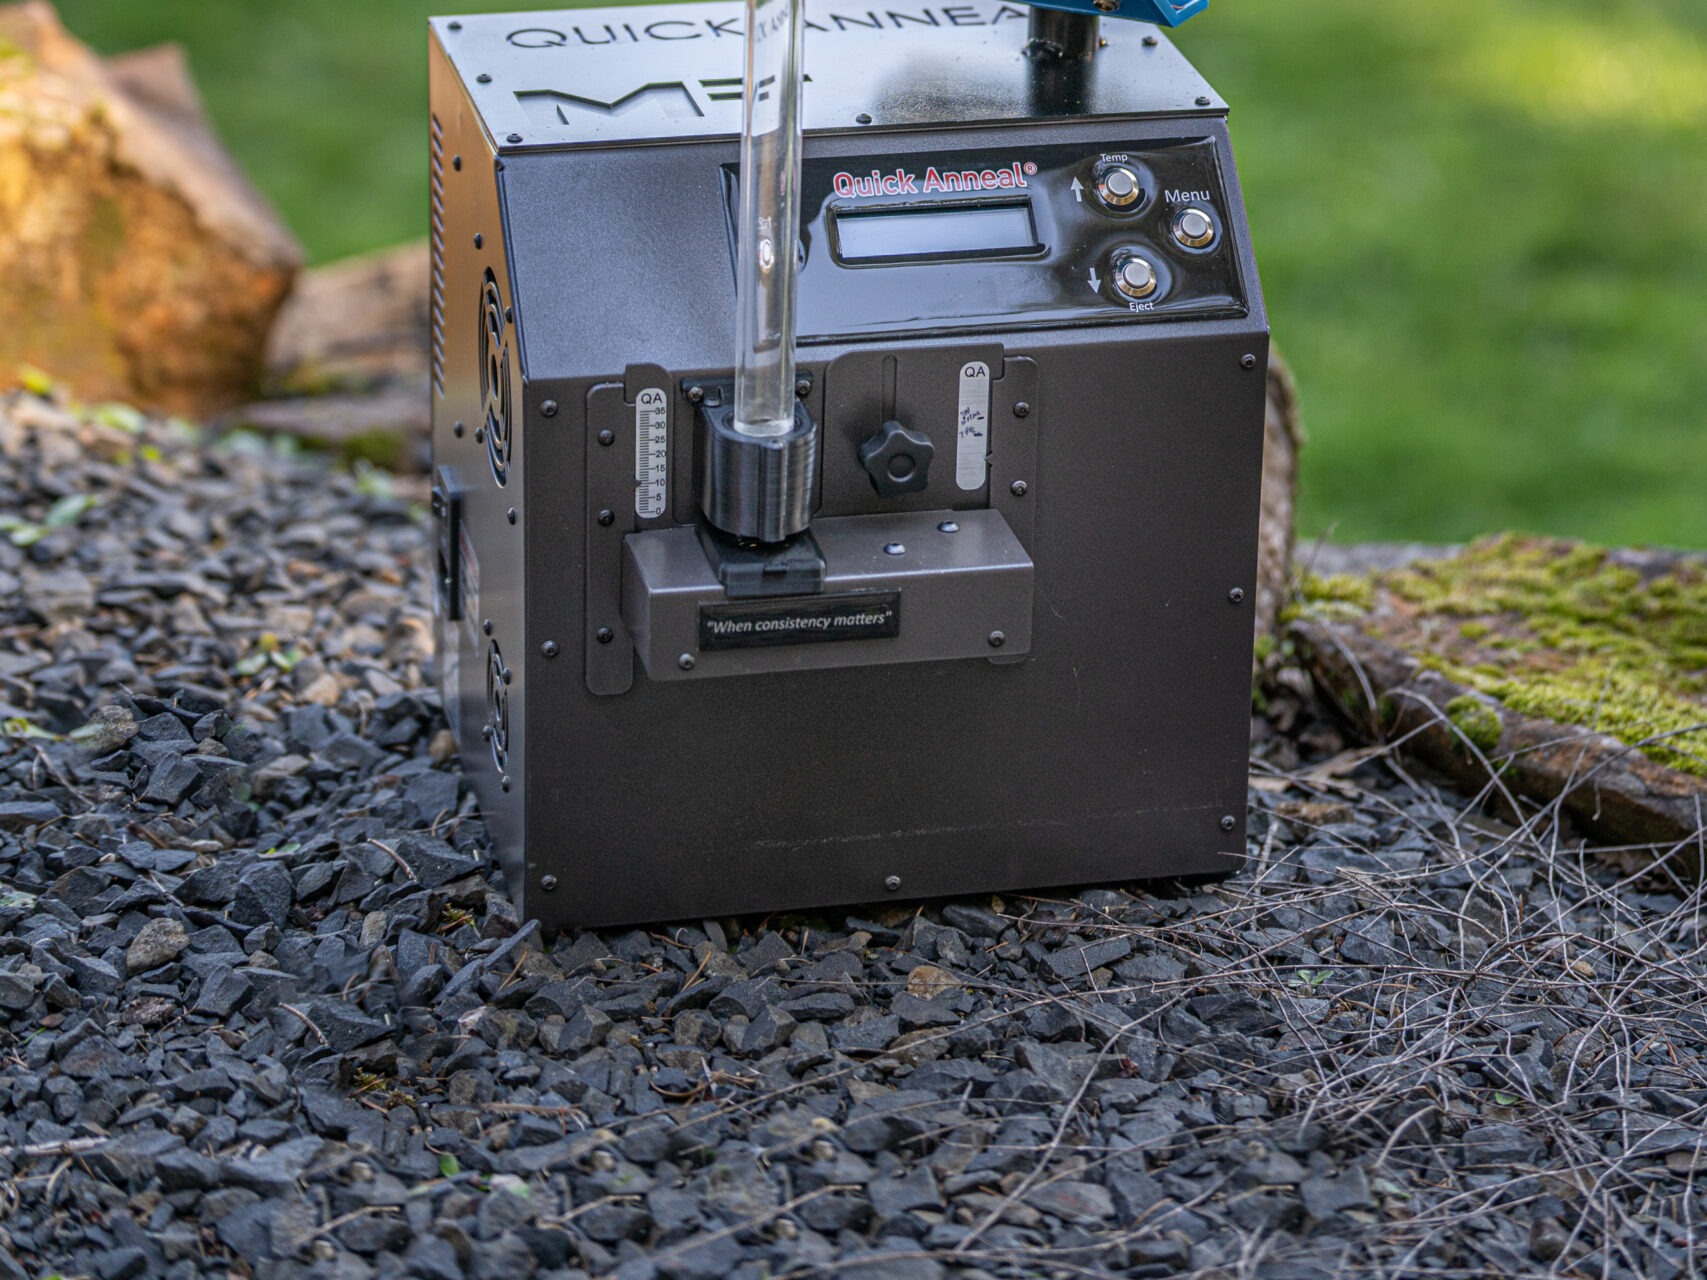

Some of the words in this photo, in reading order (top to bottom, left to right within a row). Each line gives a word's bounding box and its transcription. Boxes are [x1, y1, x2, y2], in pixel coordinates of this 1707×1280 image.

[506, 18, 745, 48] QUICK
[1100, 153, 1128, 163] Temp
[833, 169, 918, 198] Quick
[1164, 189, 1211, 203] Menu
[1129, 302, 1154, 313] Eject
[965, 366, 986, 378] QA
[641, 393, 663, 405] QA
[707, 621, 752, 634] "When
[755, 616, 831, 632] consistency
[833, 610, 893, 626] matters"
